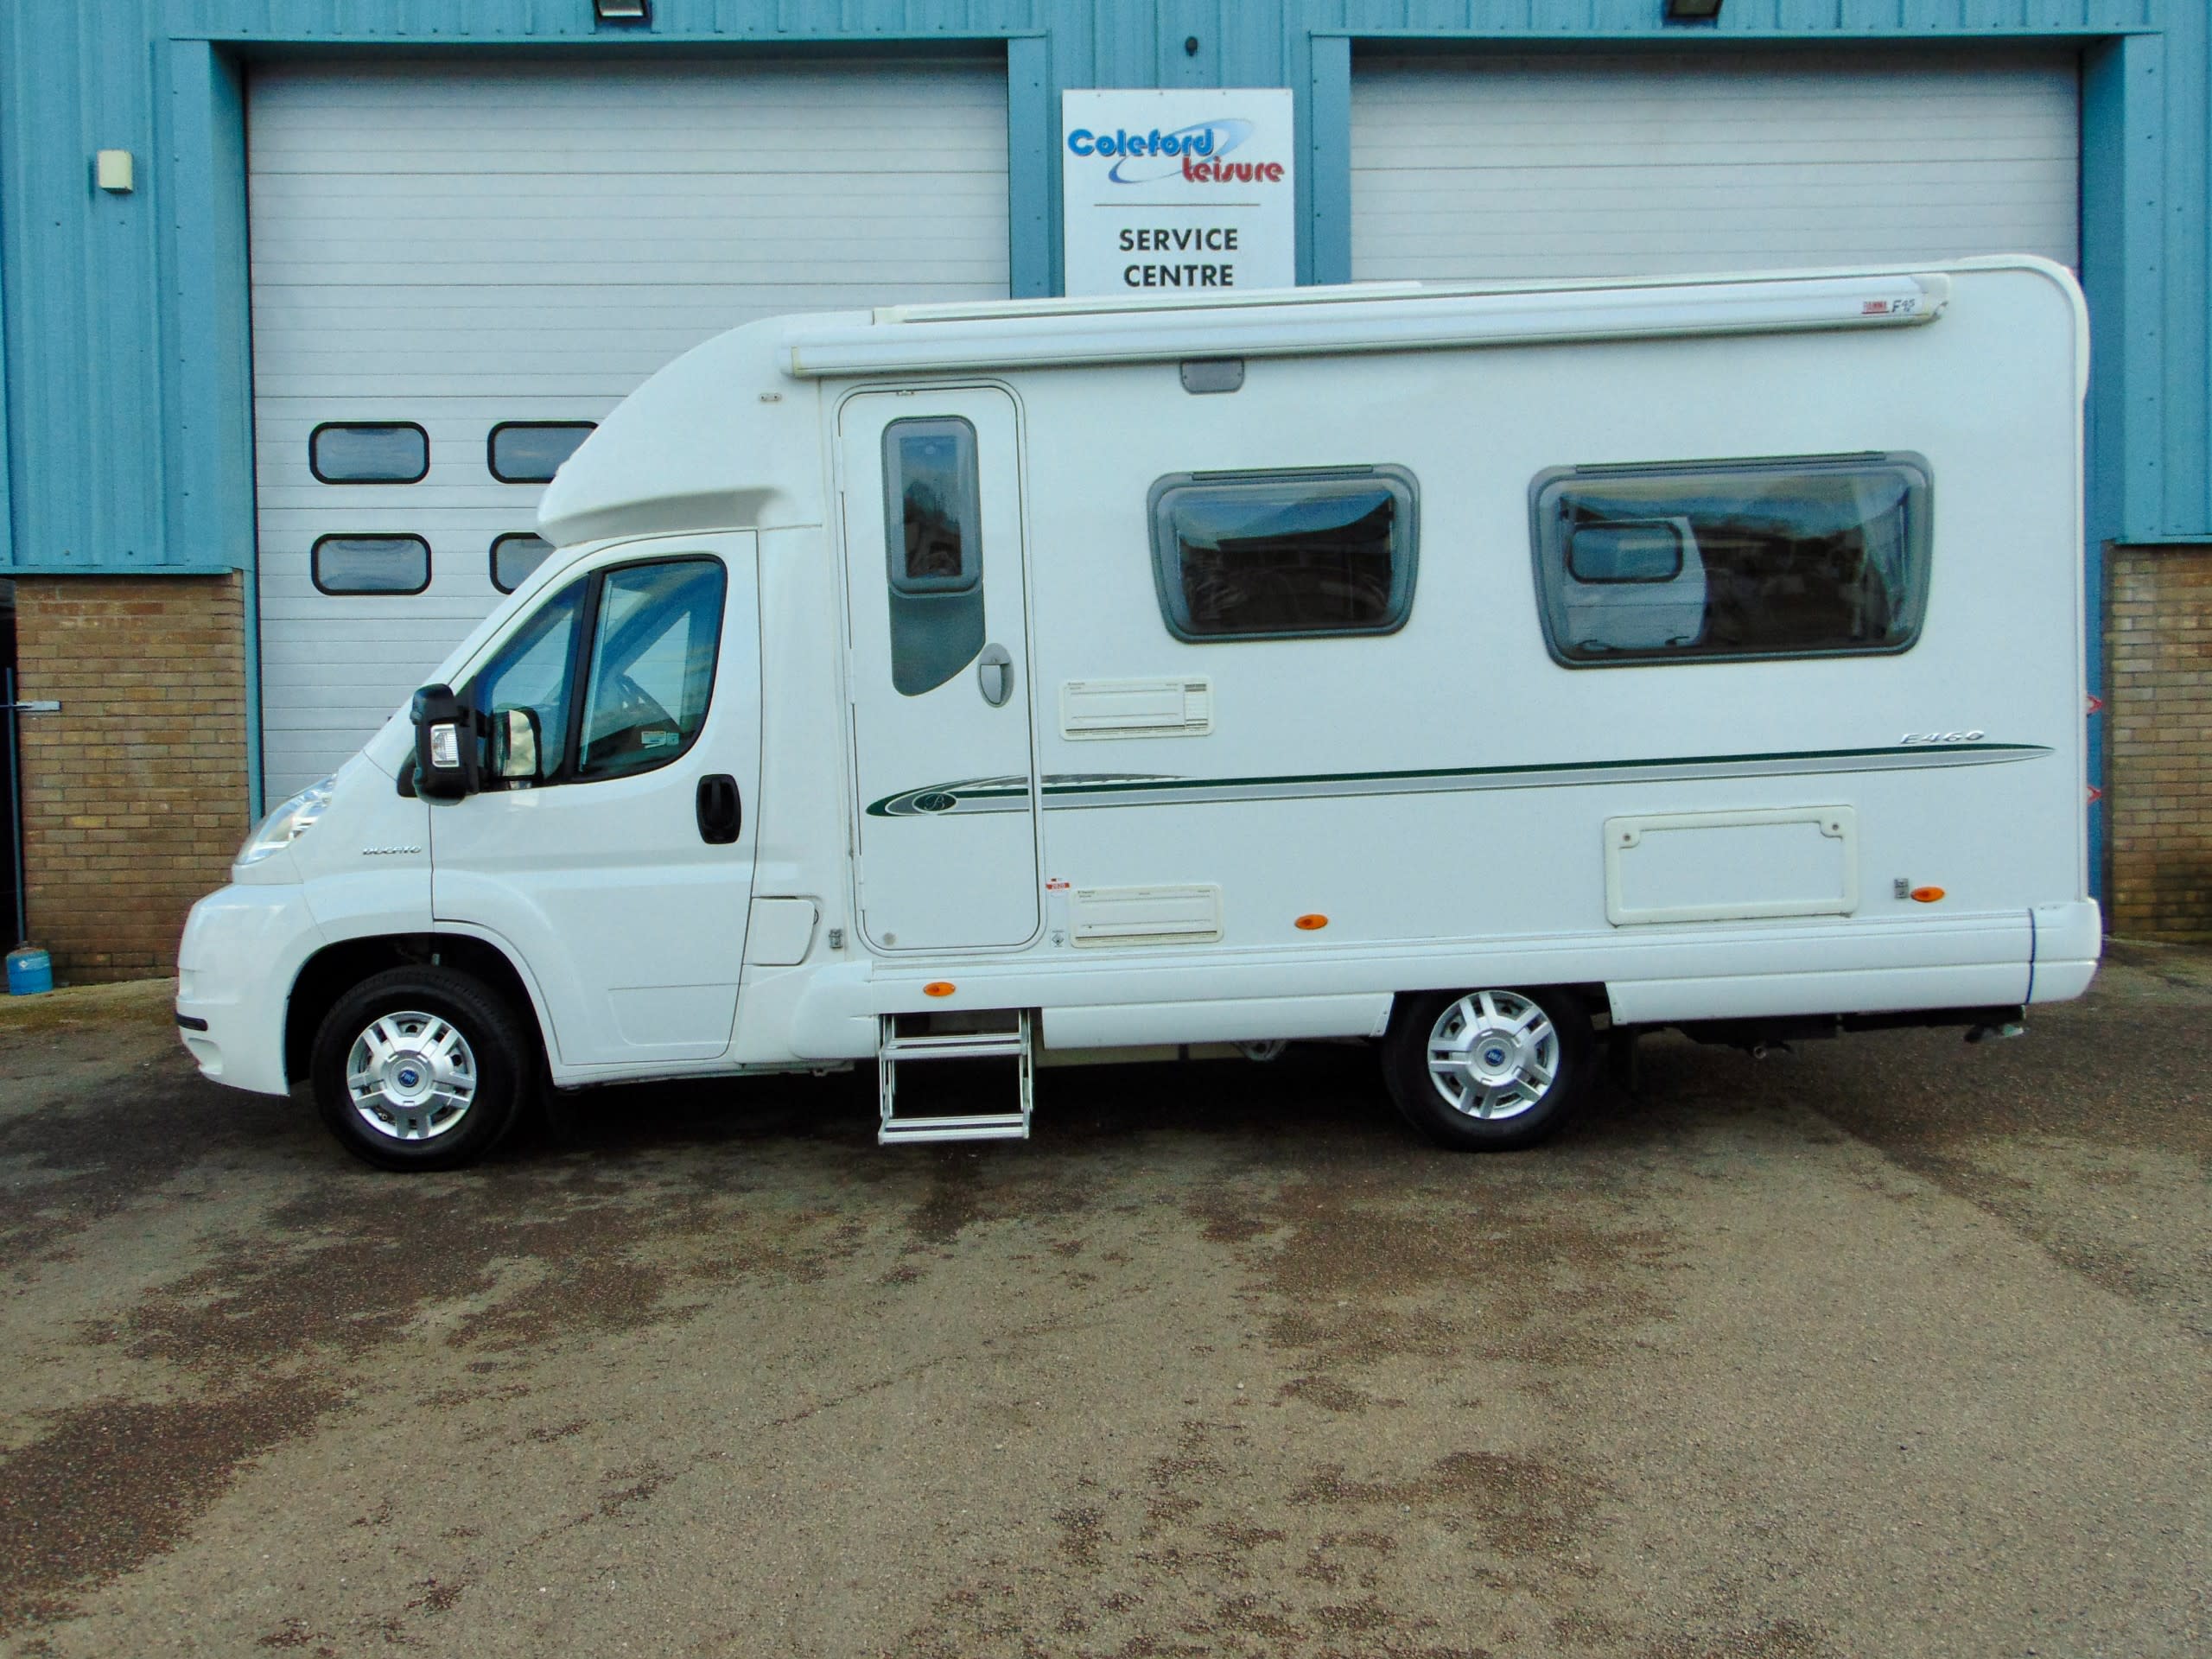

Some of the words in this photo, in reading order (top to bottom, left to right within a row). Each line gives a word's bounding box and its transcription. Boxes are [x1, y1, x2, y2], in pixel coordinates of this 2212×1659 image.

[1067, 128, 1215, 157] Coleford
[1119, 228, 1238, 251] SERVICE
[1123, 264, 1234, 288] CENTRE
[1900, 730, 1985, 745] E460
